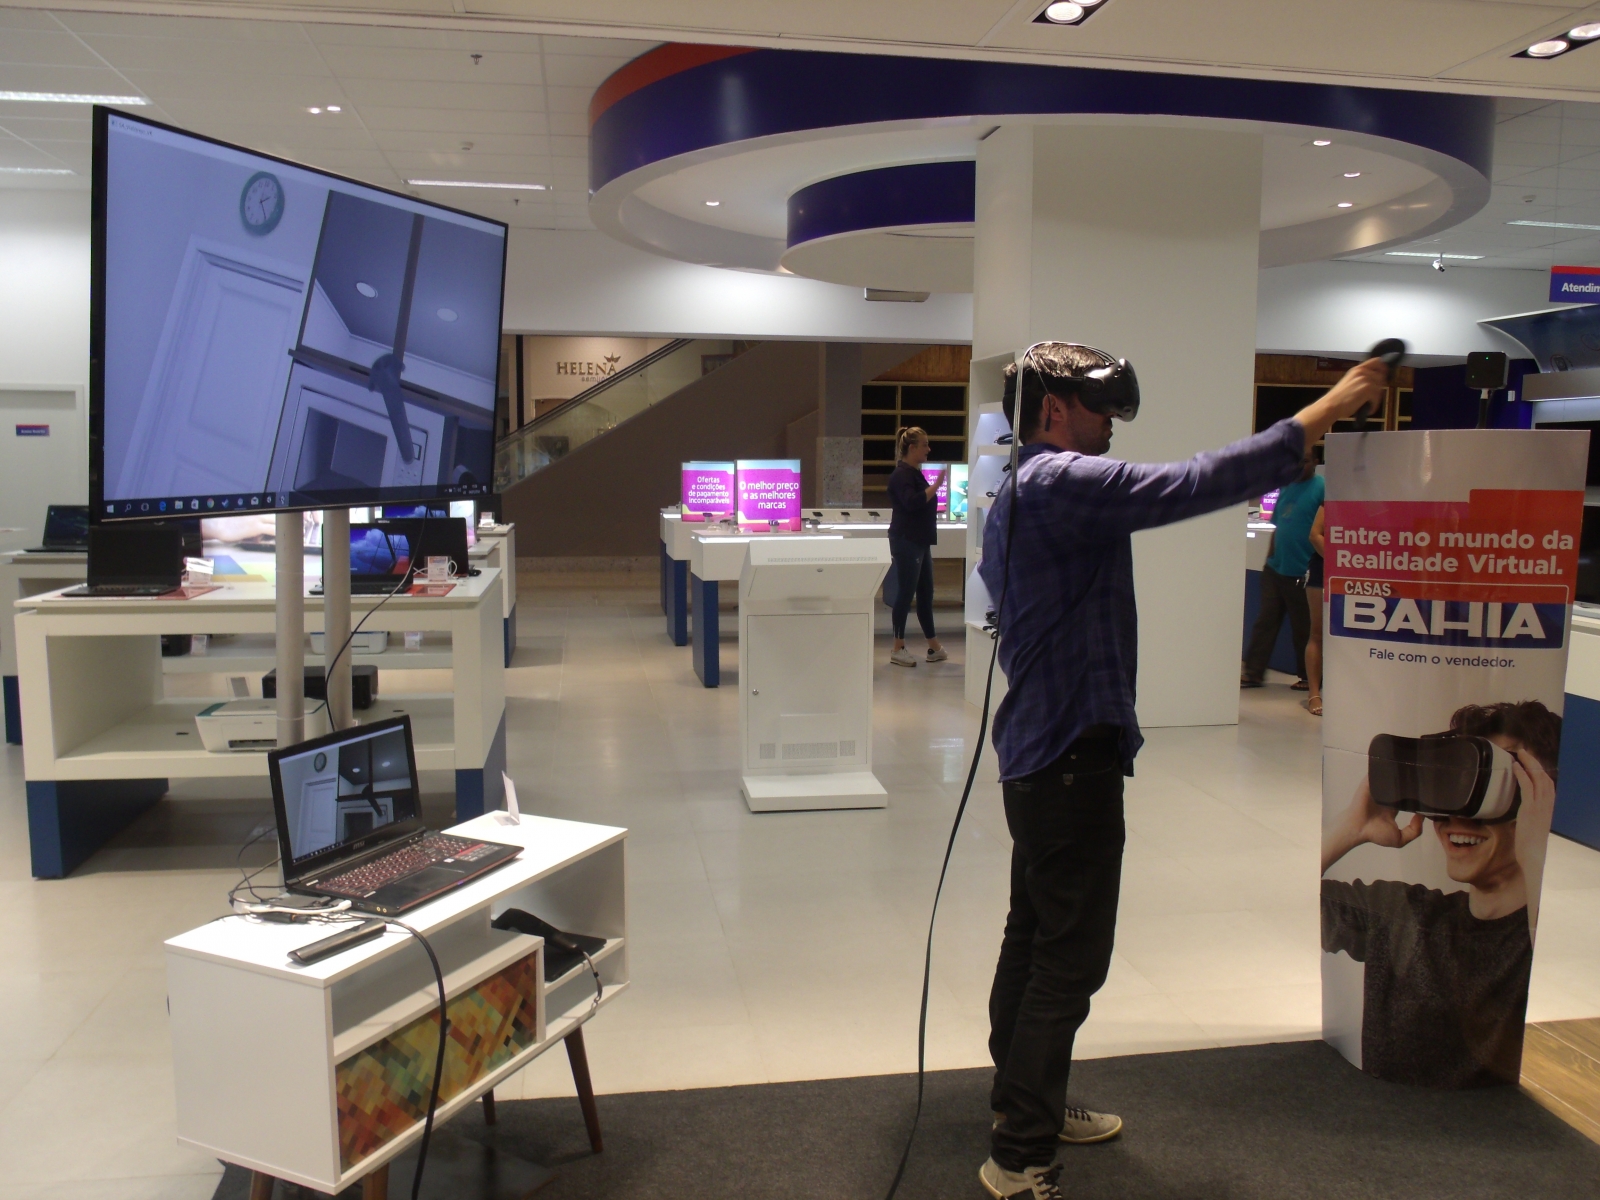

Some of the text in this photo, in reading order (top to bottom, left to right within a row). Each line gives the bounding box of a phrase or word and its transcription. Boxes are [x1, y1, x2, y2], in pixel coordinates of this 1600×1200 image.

[556, 362, 617, 375] HELENA
[697, 483, 726, 491] condições
[740, 481, 799, 491] O melhor preço
[760, 491, 796, 499] melhores
[758, 501, 787, 509] marcas
[1330, 526, 1573, 550] Entre no mundo da
[1336, 550, 1563, 575] Realidade Virtual.
[1344, 581, 1391, 597] CASAS
[1344, 594, 1546, 639] BAHIA
[1369, 648, 1515, 669] Fale com o vendedor.
